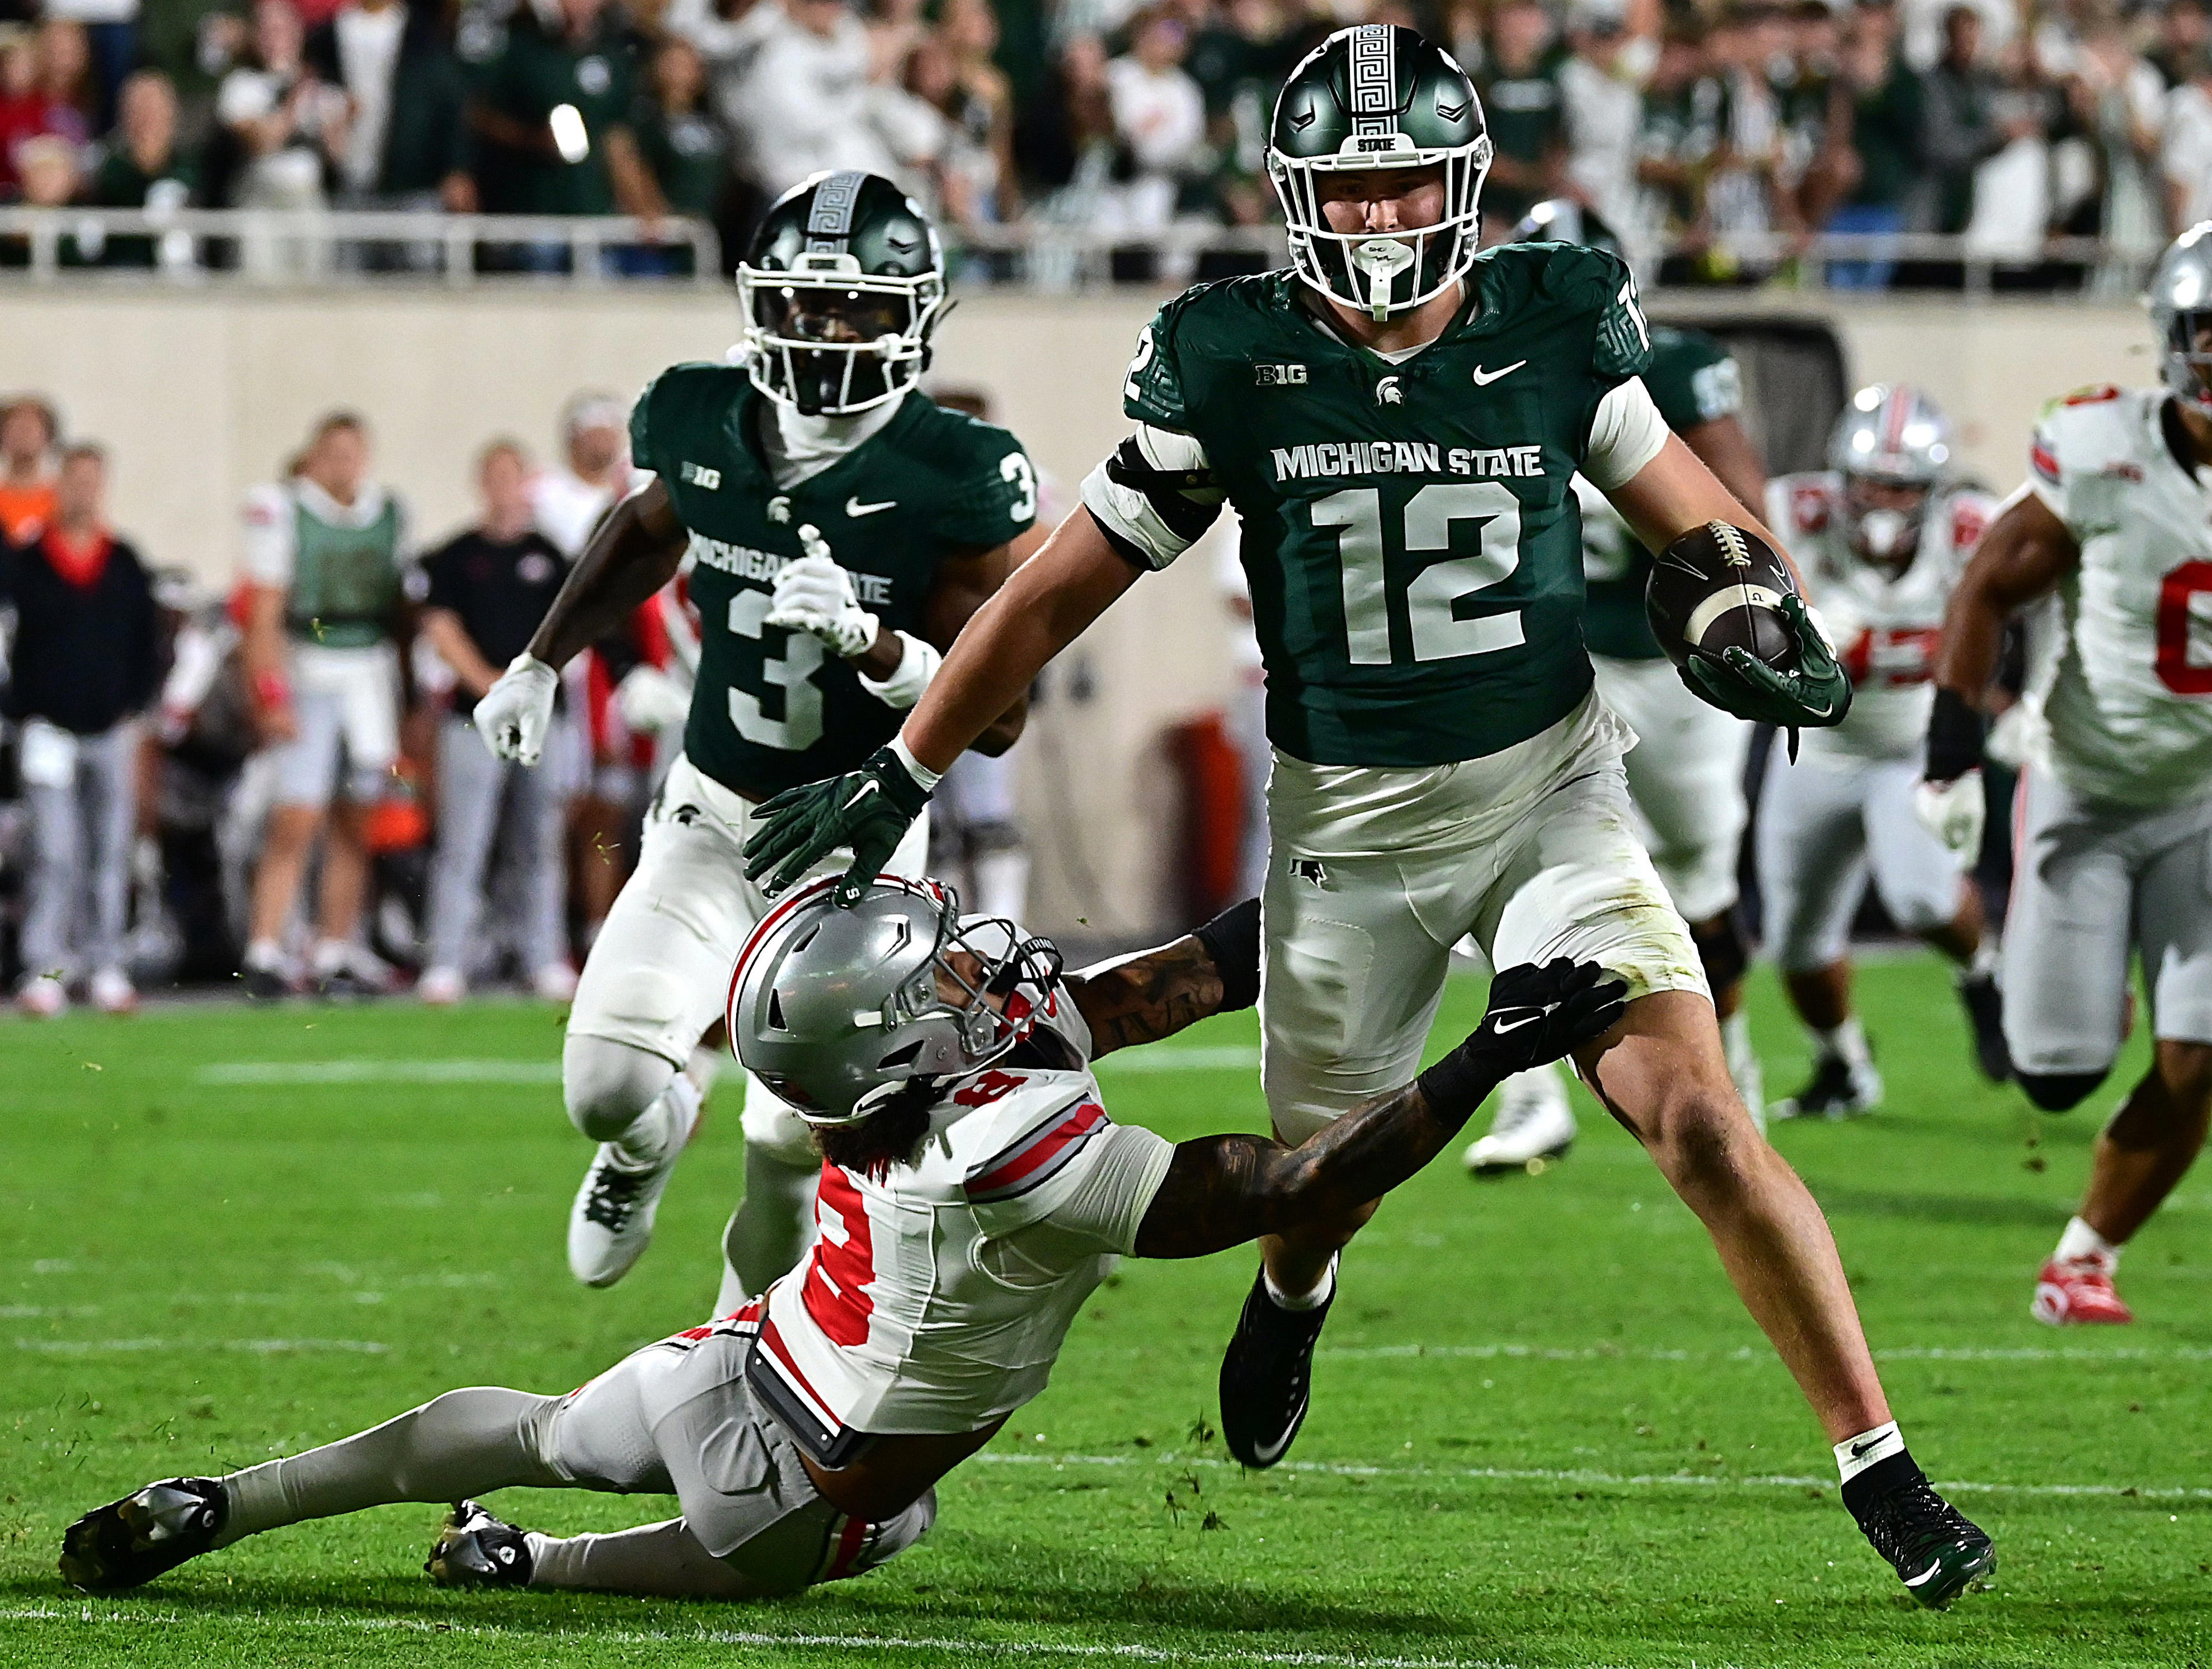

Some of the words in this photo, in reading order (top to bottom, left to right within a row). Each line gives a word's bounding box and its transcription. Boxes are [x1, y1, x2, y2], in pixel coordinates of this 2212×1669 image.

[1357, 138, 1396, 152] STATE
[999, 451, 1035, 522] 3
[1269, 441, 1442, 482] MICHIGAN
[1448, 445, 1546, 477] STATE
[1311, 481, 1527, 665] 12
[728, 587, 823, 751] 3
